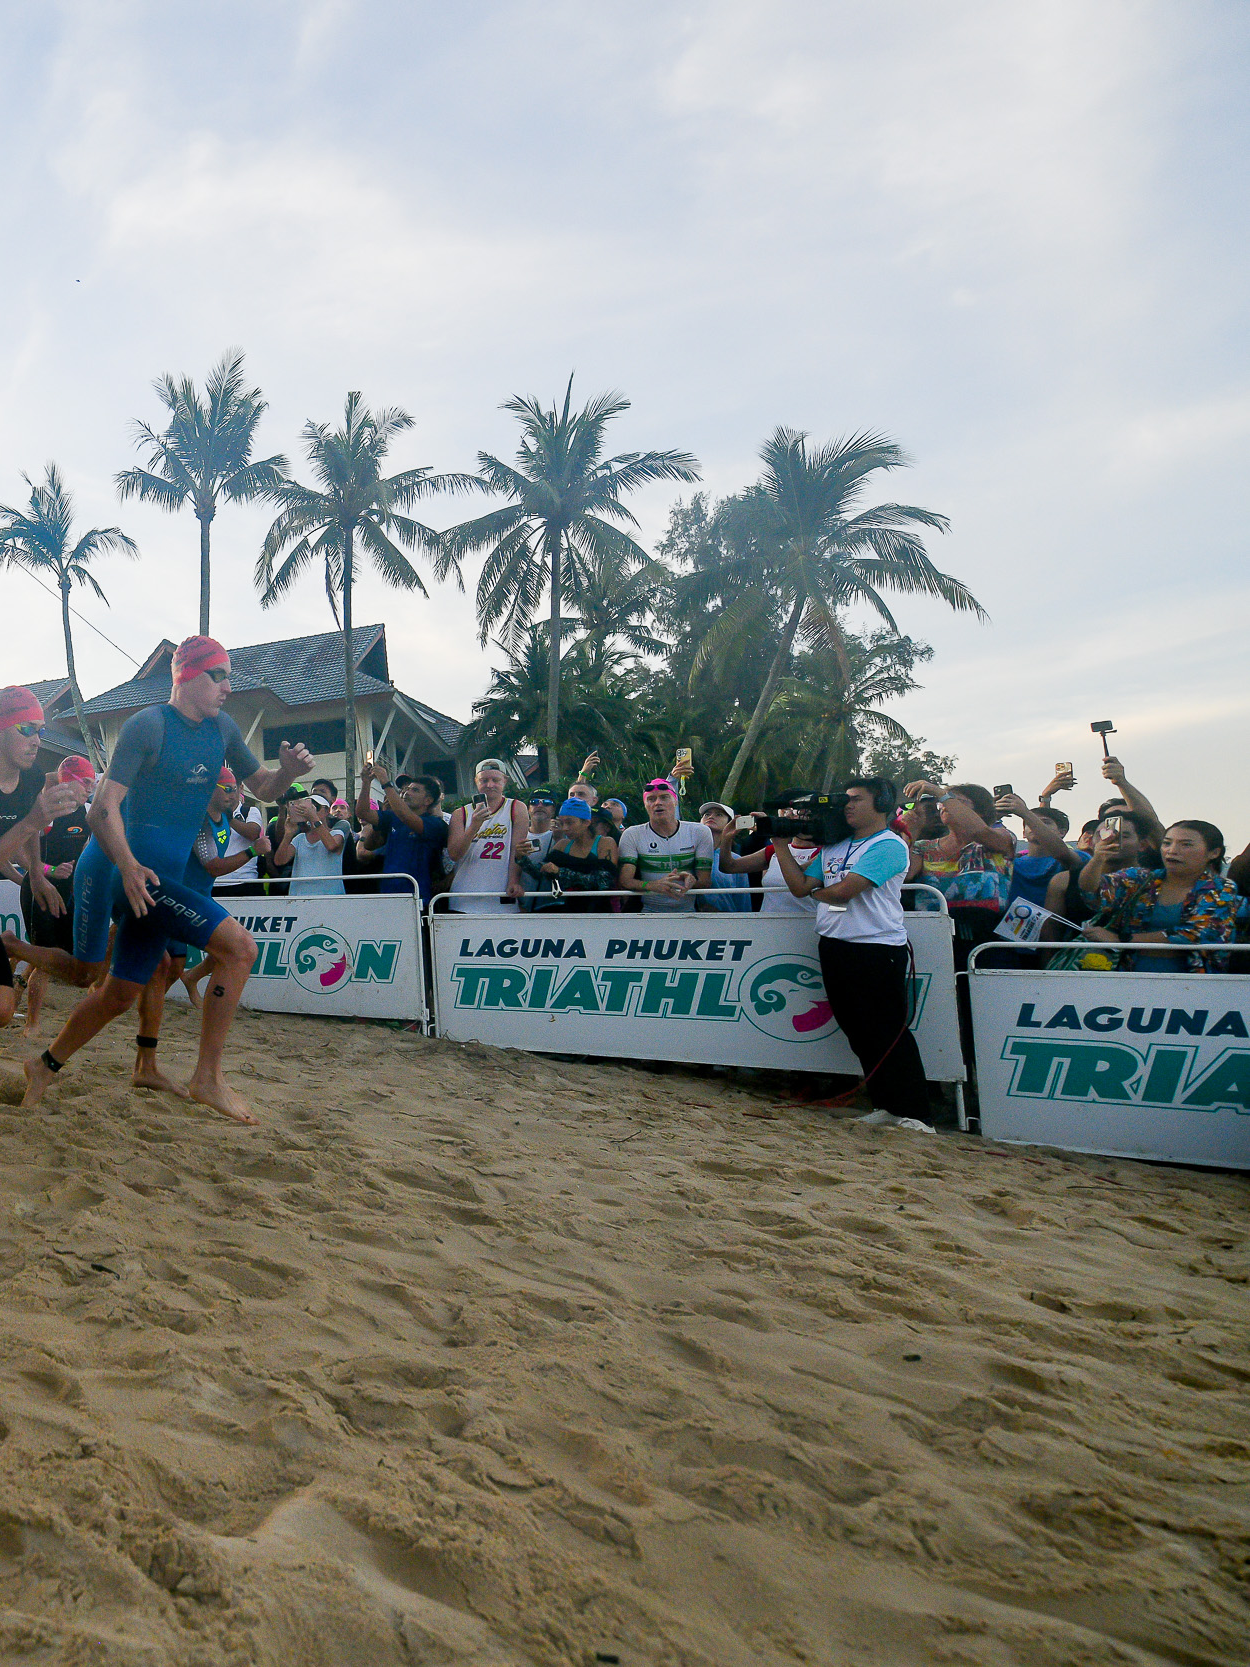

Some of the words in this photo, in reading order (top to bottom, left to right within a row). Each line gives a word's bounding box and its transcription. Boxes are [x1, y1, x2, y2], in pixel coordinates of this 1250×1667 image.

[480, 842, 505, 860] 22
[458, 938, 587, 959] LAGUNA
[604, 939, 752, 962] PHUKET
[213, 984, 225, 997] 5
[1016, 1003, 1250, 1038] LAGUNA
